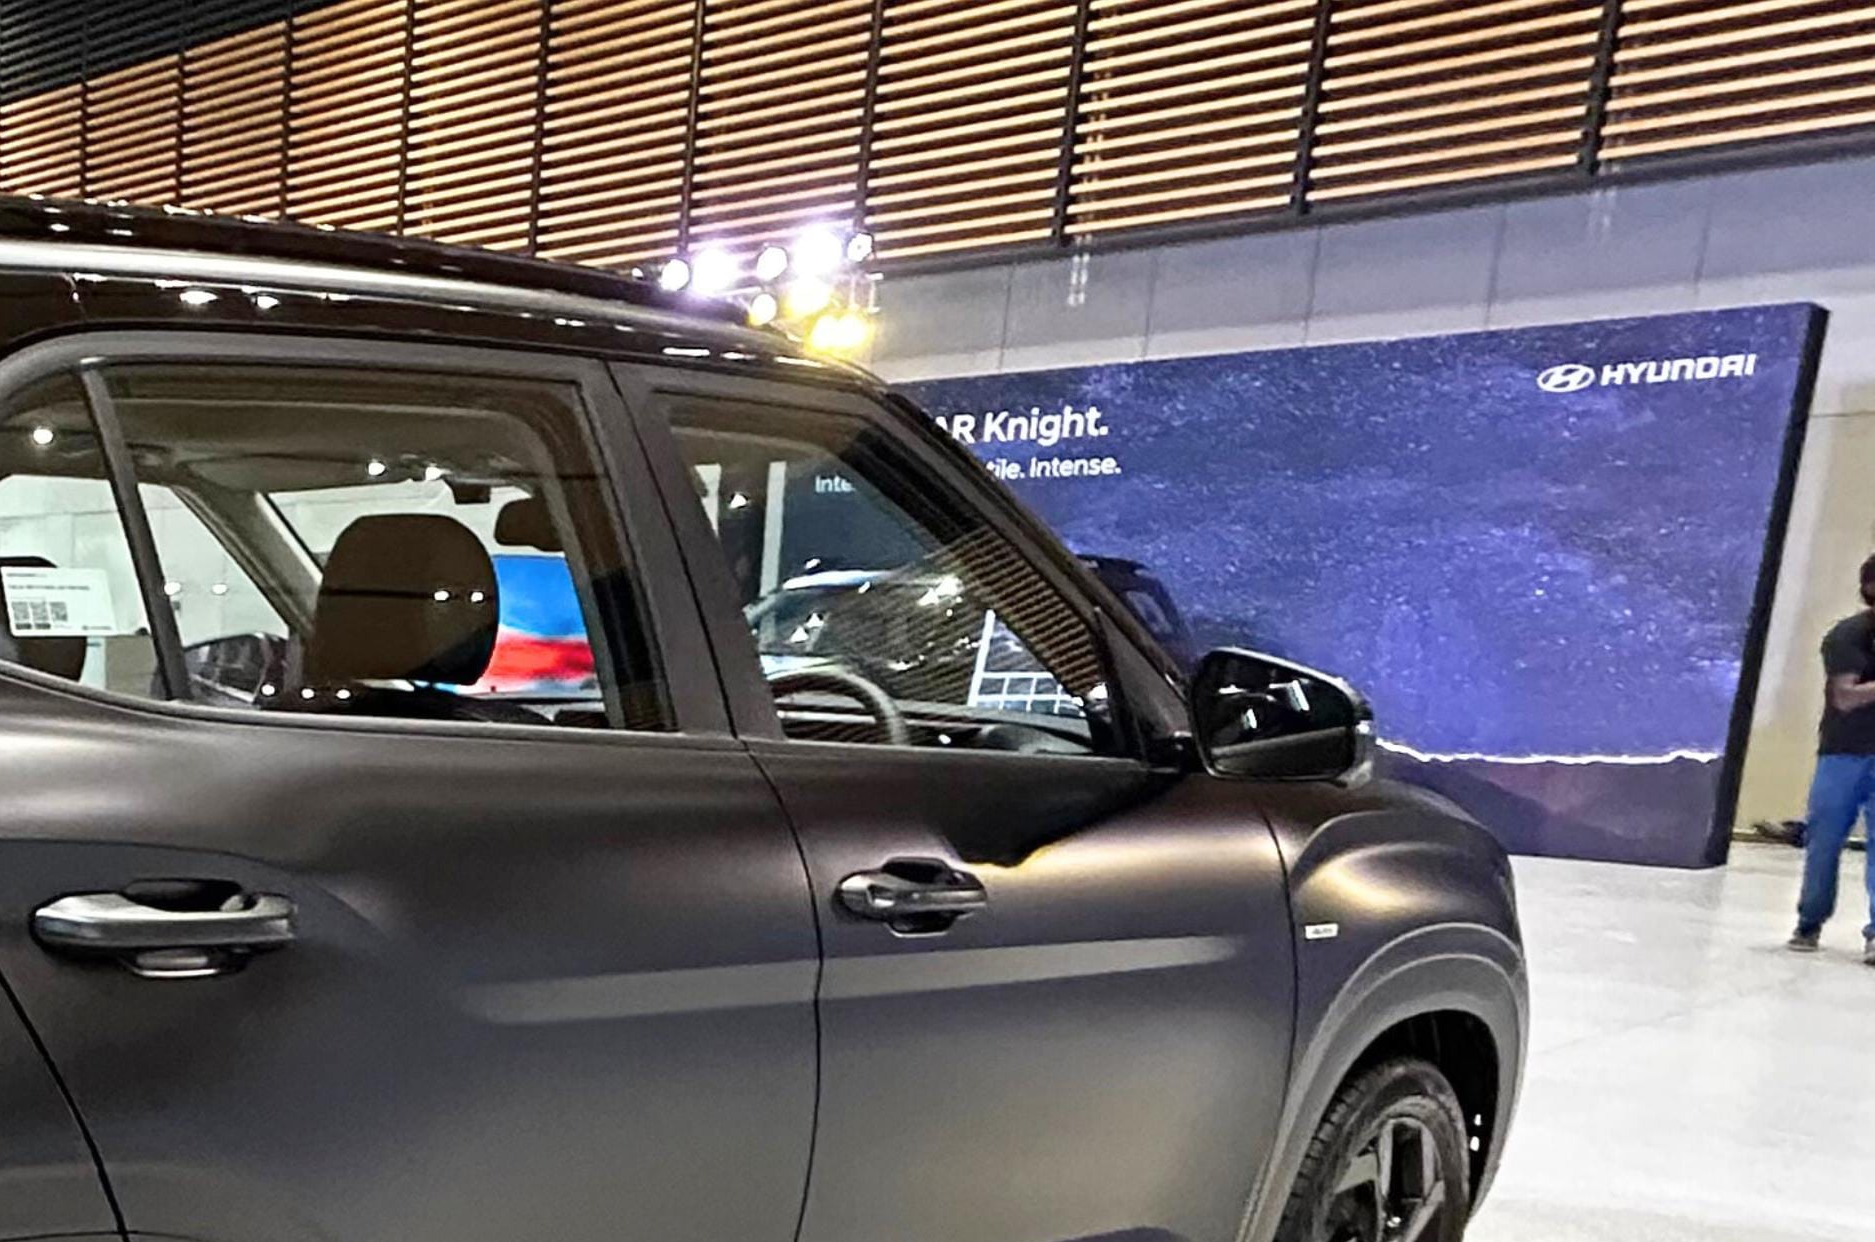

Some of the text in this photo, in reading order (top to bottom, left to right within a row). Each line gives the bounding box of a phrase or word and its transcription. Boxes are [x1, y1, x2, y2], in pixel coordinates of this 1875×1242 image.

[1601, 354, 1757, 386] HYUNDAI
[982, 405, 1109, 447] Knight.
[1029, 456, 1122, 478] Intense.
